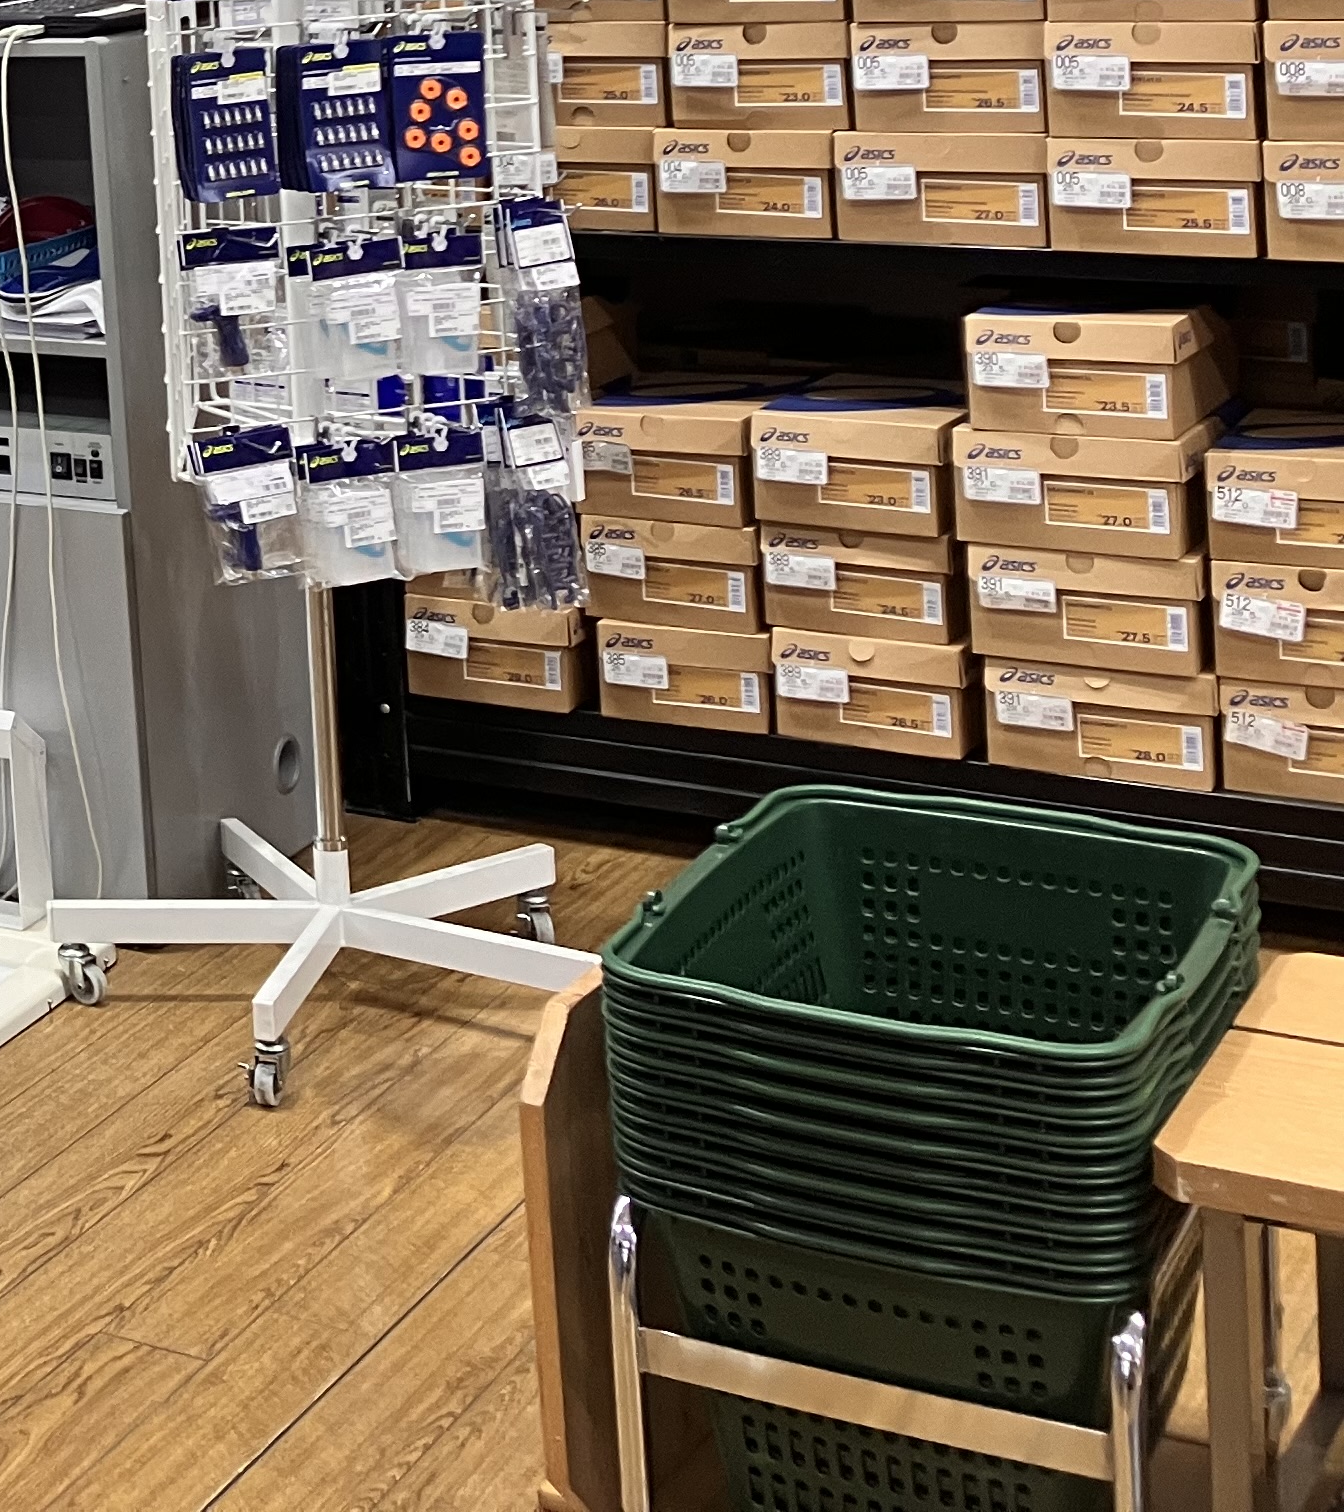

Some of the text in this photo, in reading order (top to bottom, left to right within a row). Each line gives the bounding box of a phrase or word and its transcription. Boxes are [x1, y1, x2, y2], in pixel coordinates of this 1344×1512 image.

[1055, 55, 1079, 69] 005
[1280, 62, 1306, 76] 008
[1280, 183, 1306, 197] 008
[1216, 485, 1243, 502] 512
[1225, 593, 1252, 611] 512
[1231, 711, 1256, 728] 512
